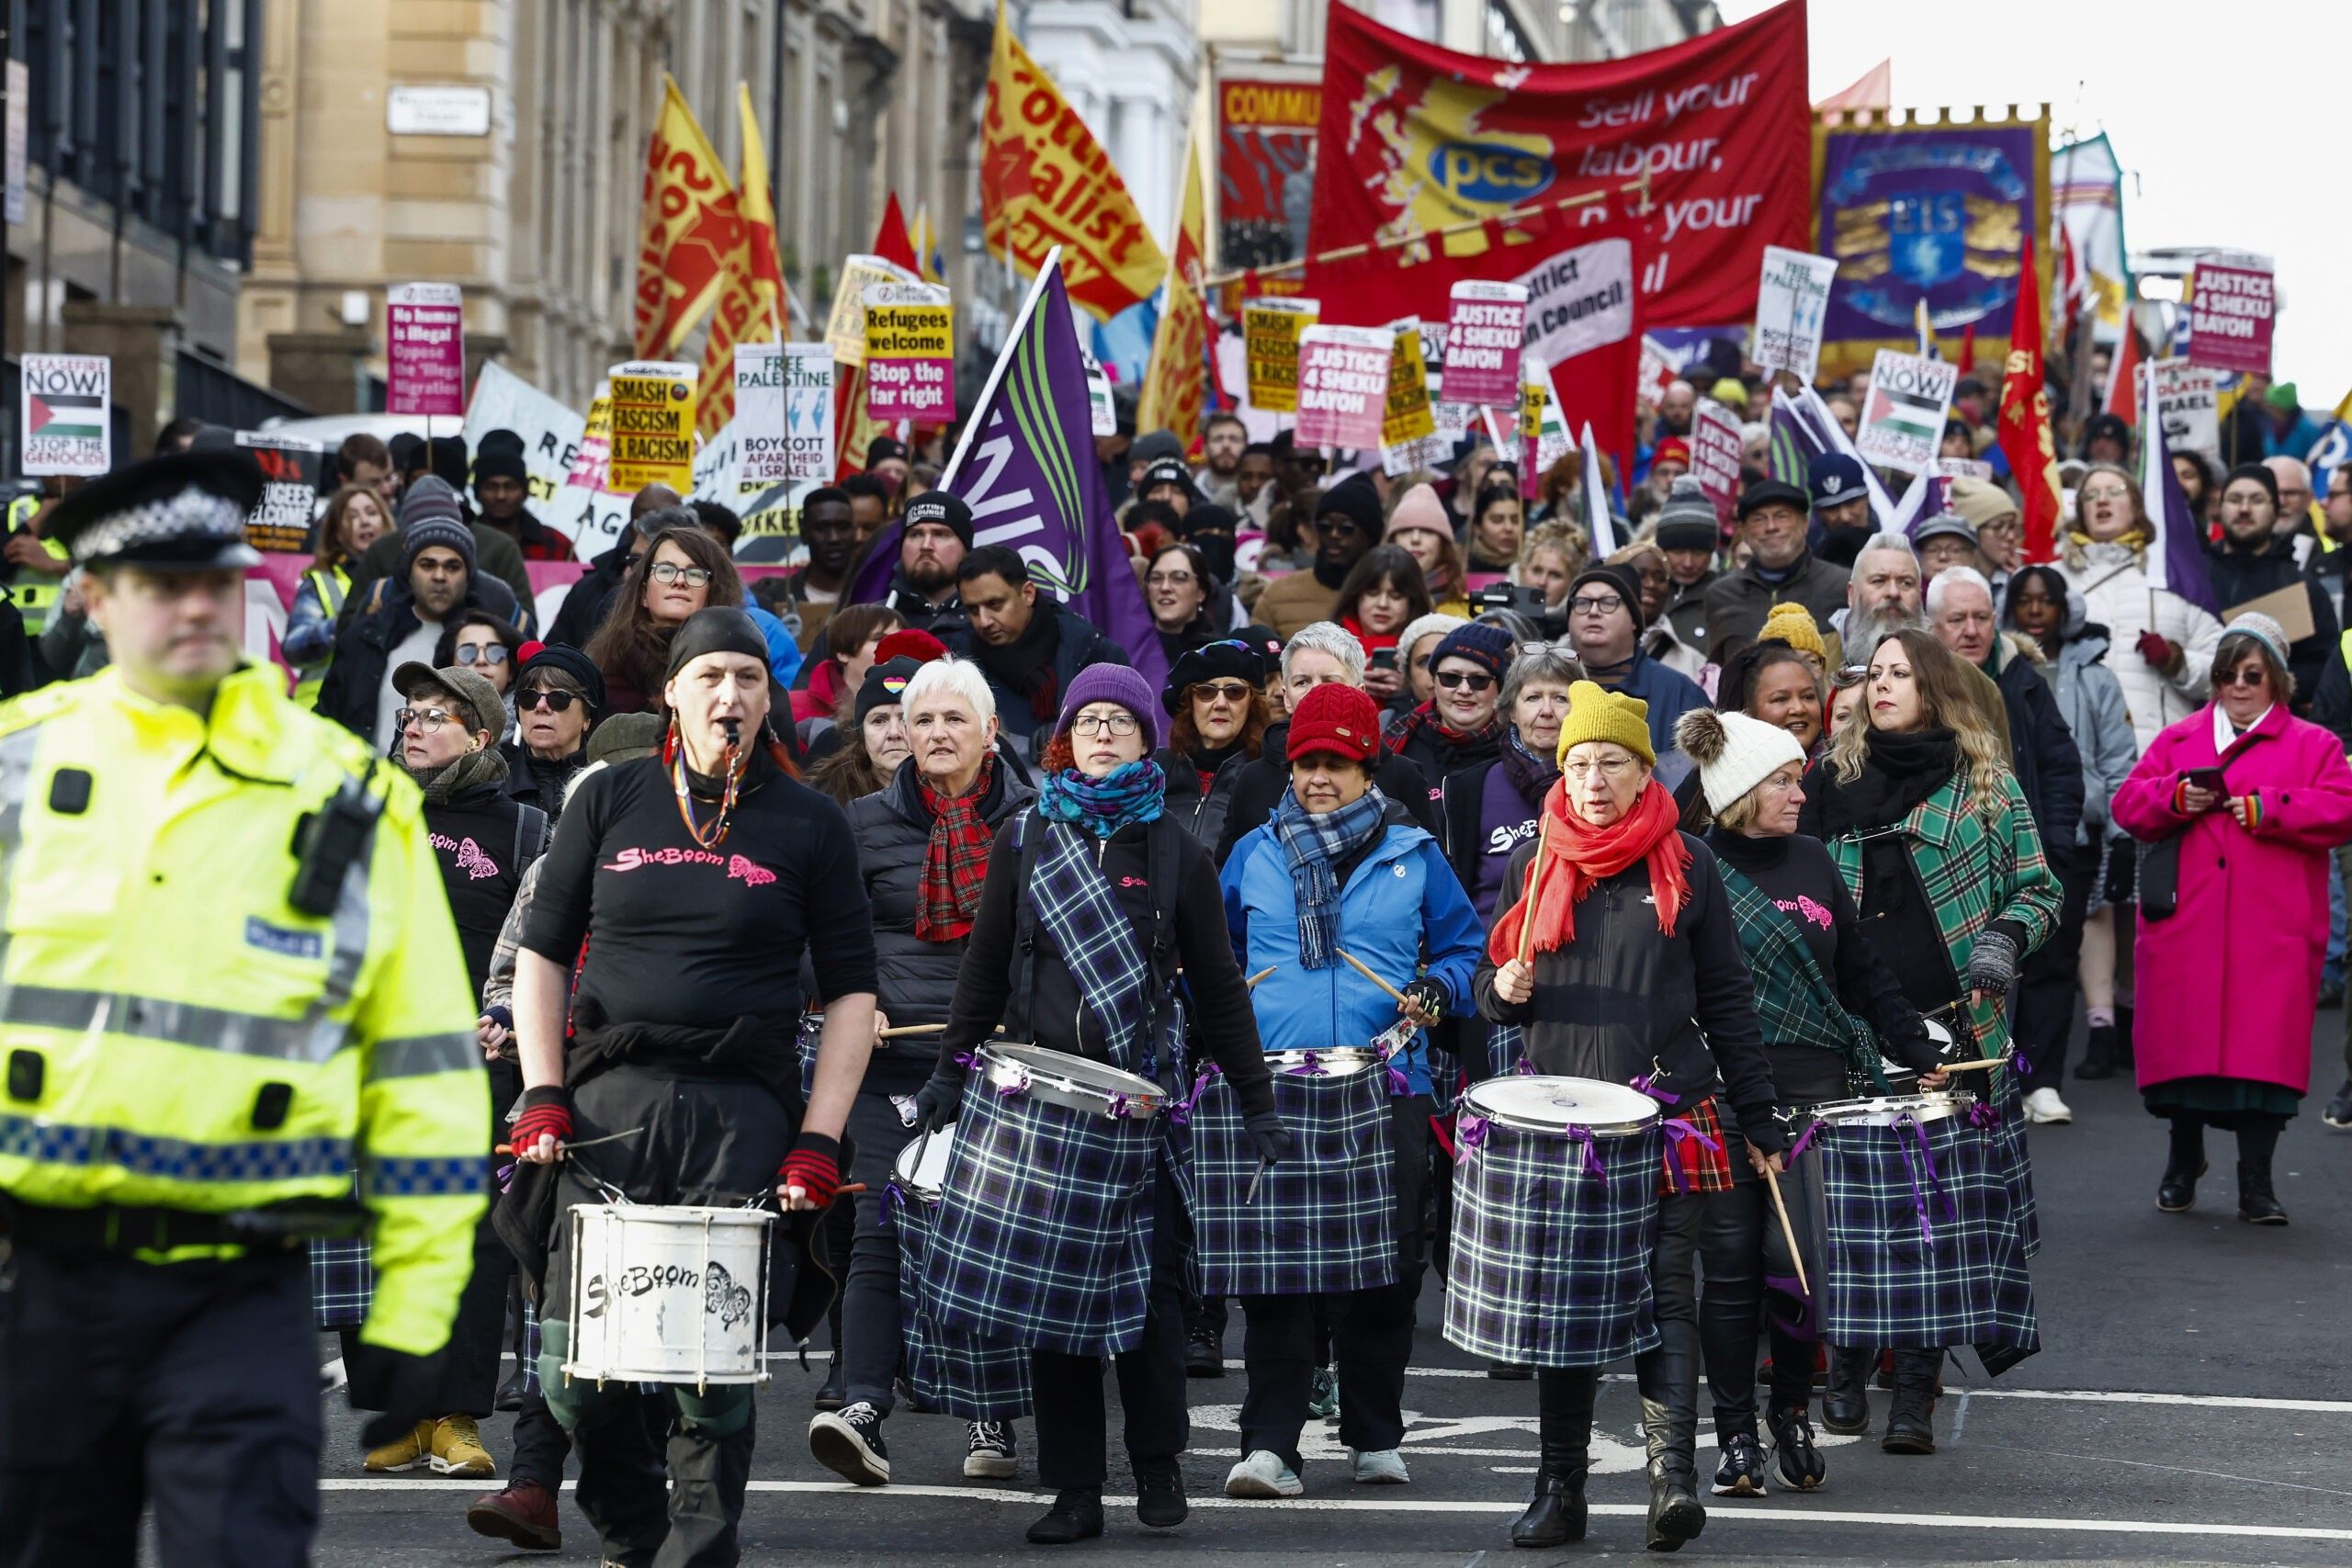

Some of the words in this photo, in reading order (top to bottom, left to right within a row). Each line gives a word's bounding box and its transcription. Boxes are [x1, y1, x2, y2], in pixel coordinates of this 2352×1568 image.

[1226, 85, 1320, 126] COMMU
[1577, 94, 1654, 129] Sell
[1662, 73, 1759, 127] your
[1577, 139, 1724, 176] labour,
[1445, 148, 1542, 197] pcs
[1660, 194, 1762, 243] your
[1527, 257, 1579, 305] strict
[2195, 272, 2272, 298] JUSTICE
[393, 307, 413, 323] No
[1452, 303, 1522, 328] JUSTICE
[1541, 280, 1623, 334] Council
[2194, 292, 2207, 310] 4
[2209, 294, 2273, 320] SHEKU
[866, 309, 949, 333] Refugees
[2193, 313, 2255, 339] BAYOH
[407, 324, 452, 344] illegal
[869, 333, 945, 351] welcome
[1450, 325, 1463, 345] 4
[1464, 327, 1521, 349] SHEKU
[764, 356, 805, 372] FREE
[1306, 346, 1389, 374] JUSTICE
[1445, 347, 1504, 370] BAYOH
[26, 369, 106, 395] NOW!
[738, 371, 831, 388] PALESTINE
[869, 362, 910, 386] Stop
[914, 361, 944, 382] the
[1303, 368, 1319, 388] 4
[1319, 368, 1387, 395] SHEKU
[1875, 367, 1951, 401] NOW!
[614, 379, 667, 403] SMASH
[871, 386, 898, 405] far
[900, 385, 944, 409] right
[1300, 388, 1367, 414] BAYOH
[613, 409, 680, 432] FASCISM
[29, 438, 72, 452] STOP
[76, 439, 103, 453] THE
[613, 437, 623, 457] &
[628, 438, 689, 461] RACISM
[745, 437, 825, 453] BOYCOTT
[25, 451, 106, 466] GENOCIDE
[747, 453, 824, 465] APARTHEID
[759, 465, 811, 479] ISRAEL
[243, 504, 311, 529] ELCOME
[1487, 819, 1539, 854] SheB
[602, 847, 725, 872] SheBoom
[582, 1264, 700, 1319] SheBoom
